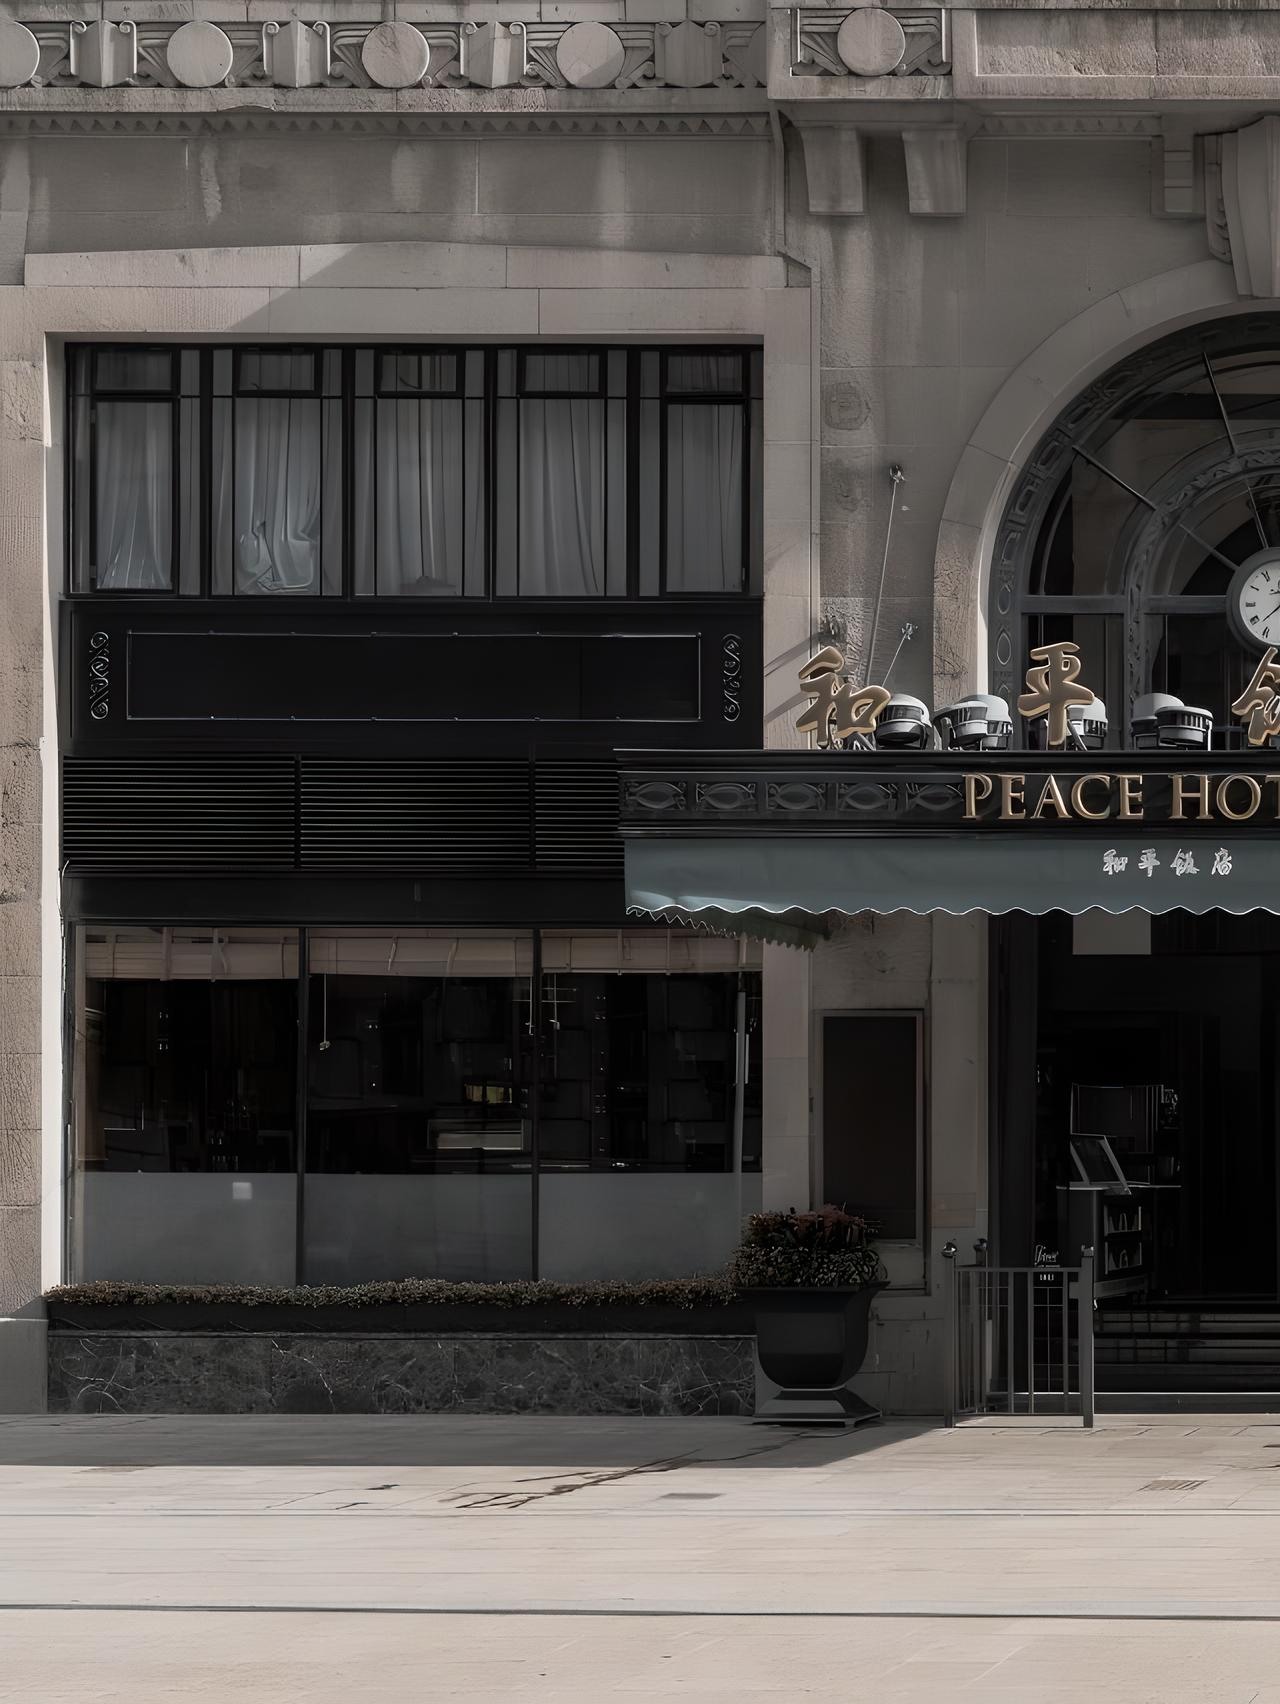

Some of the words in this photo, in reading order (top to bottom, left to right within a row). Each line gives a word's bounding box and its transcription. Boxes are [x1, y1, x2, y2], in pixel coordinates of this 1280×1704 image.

[962, 774, 1144, 820] PEACE
[1102, 848, 1233, 877] 和平飯店
